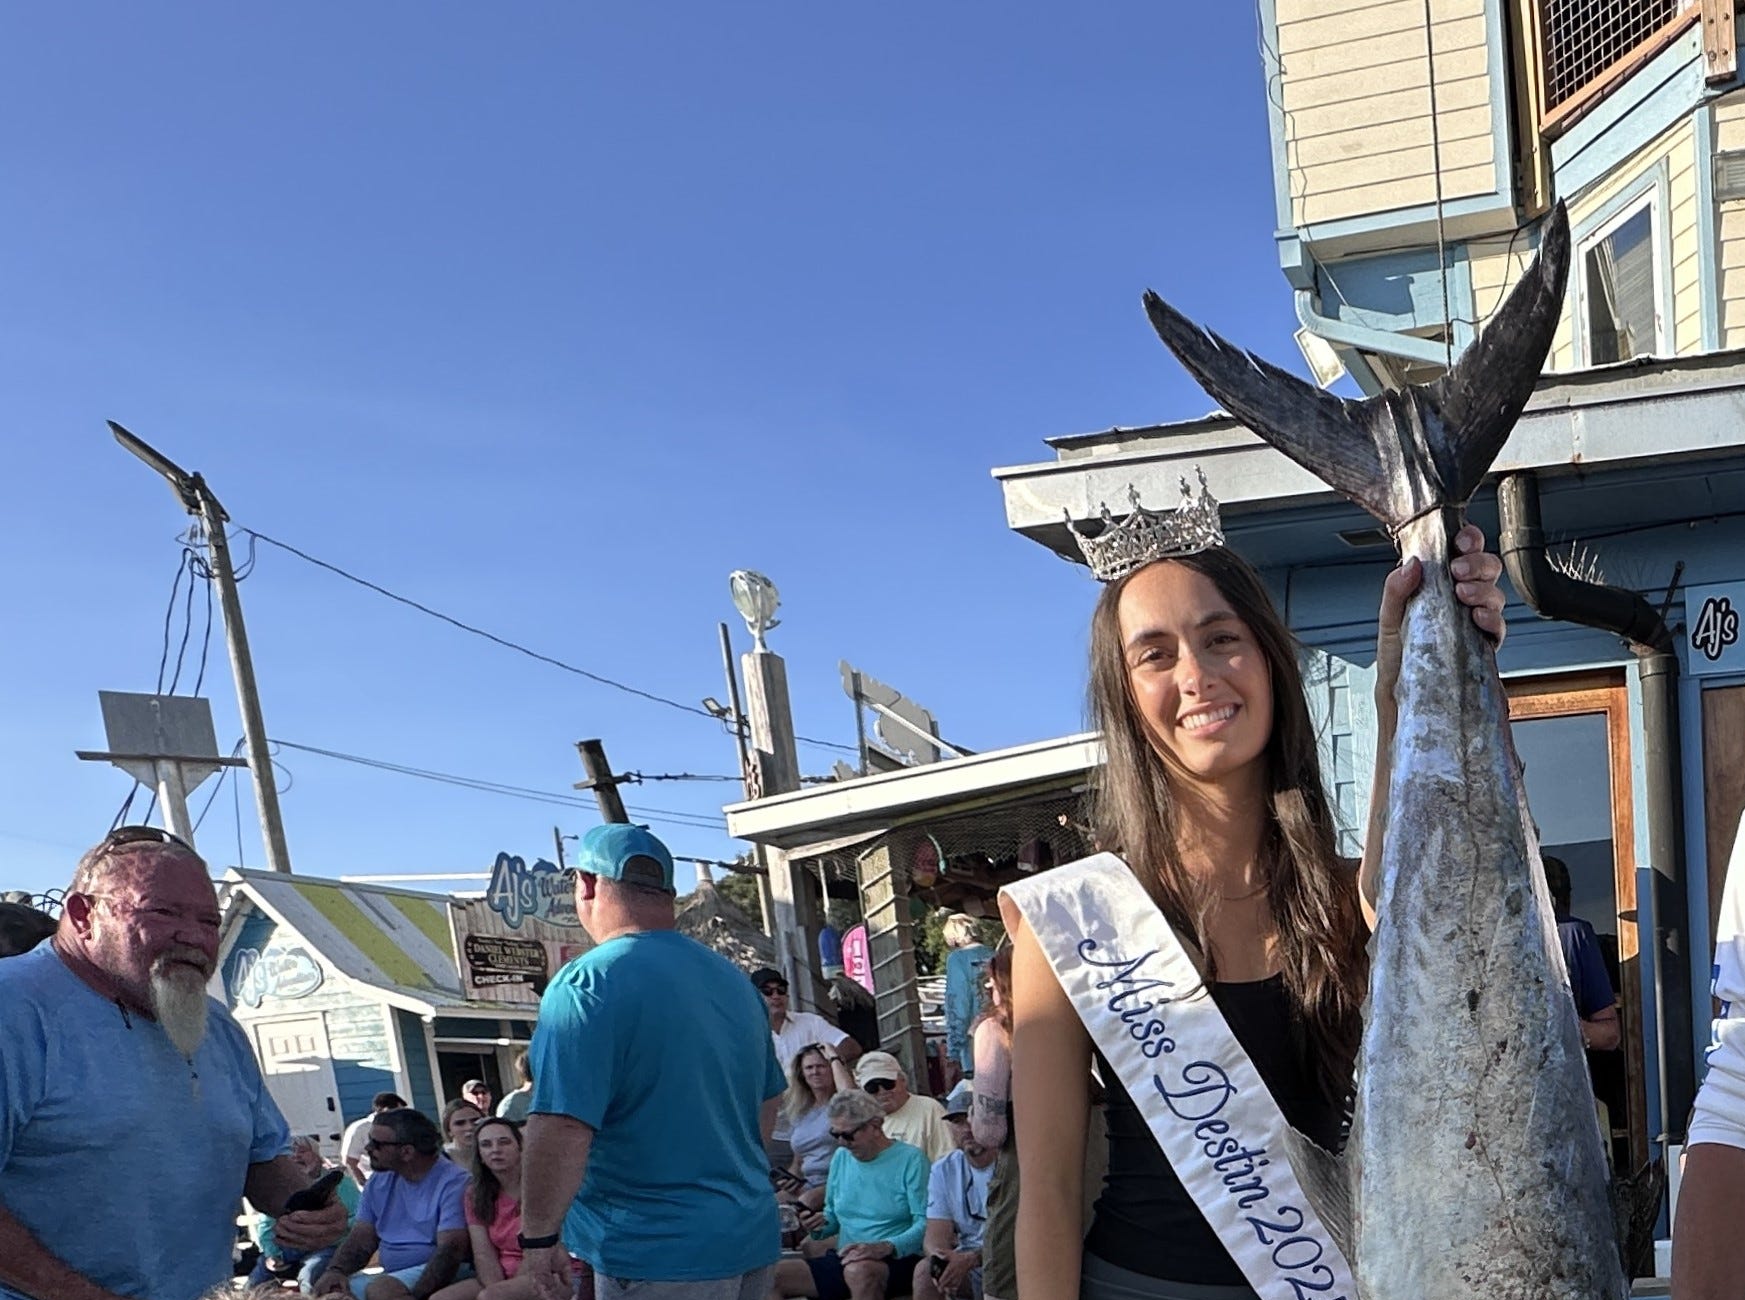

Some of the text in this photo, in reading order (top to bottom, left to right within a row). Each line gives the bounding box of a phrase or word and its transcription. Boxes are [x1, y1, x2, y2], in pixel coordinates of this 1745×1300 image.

[474, 974, 524, 985] CHECK-IN
[1077, 937, 1208, 1059] Miss
[1154, 1060, 1271, 1210] Destin
